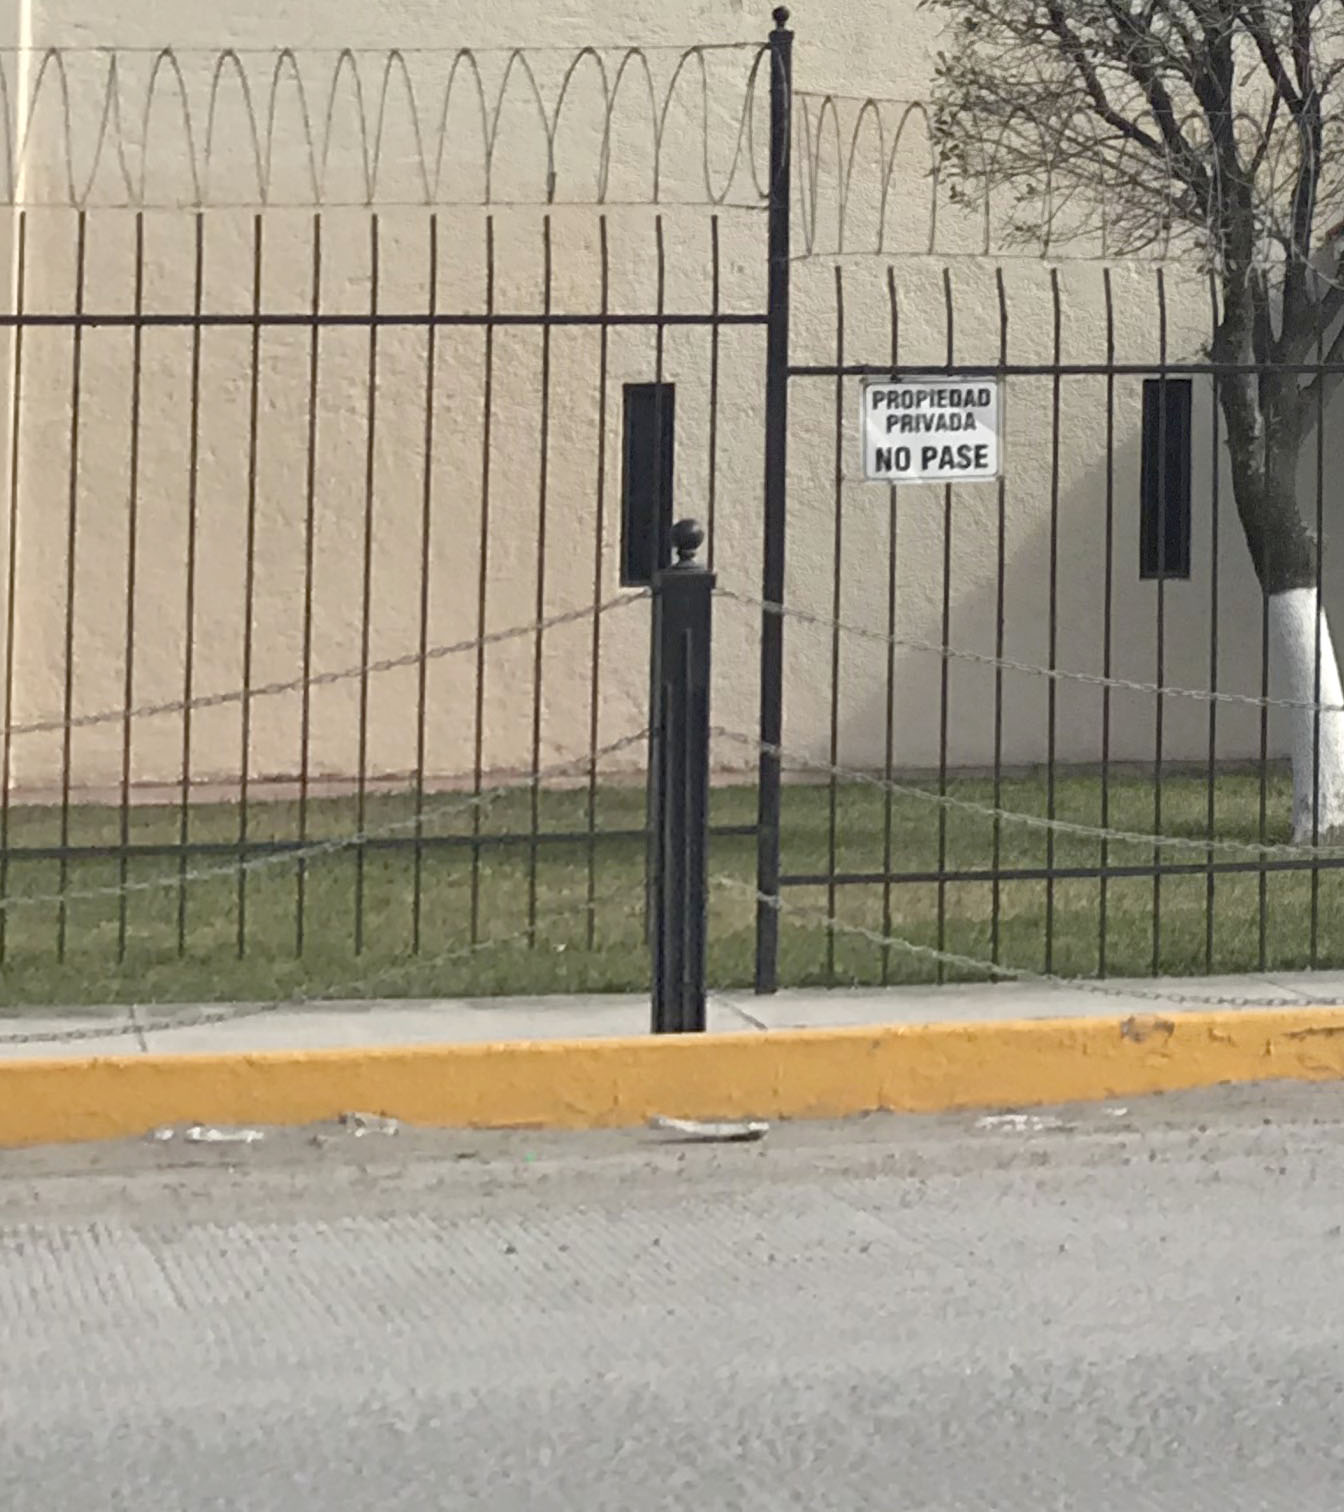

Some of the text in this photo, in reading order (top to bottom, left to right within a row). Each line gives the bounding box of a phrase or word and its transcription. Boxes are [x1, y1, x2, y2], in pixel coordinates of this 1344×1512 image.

[872, 388, 991, 410] PROPIEDAD
[886, 412, 977, 434] PRIVADA
[875, 444, 989, 473] NO PASE
